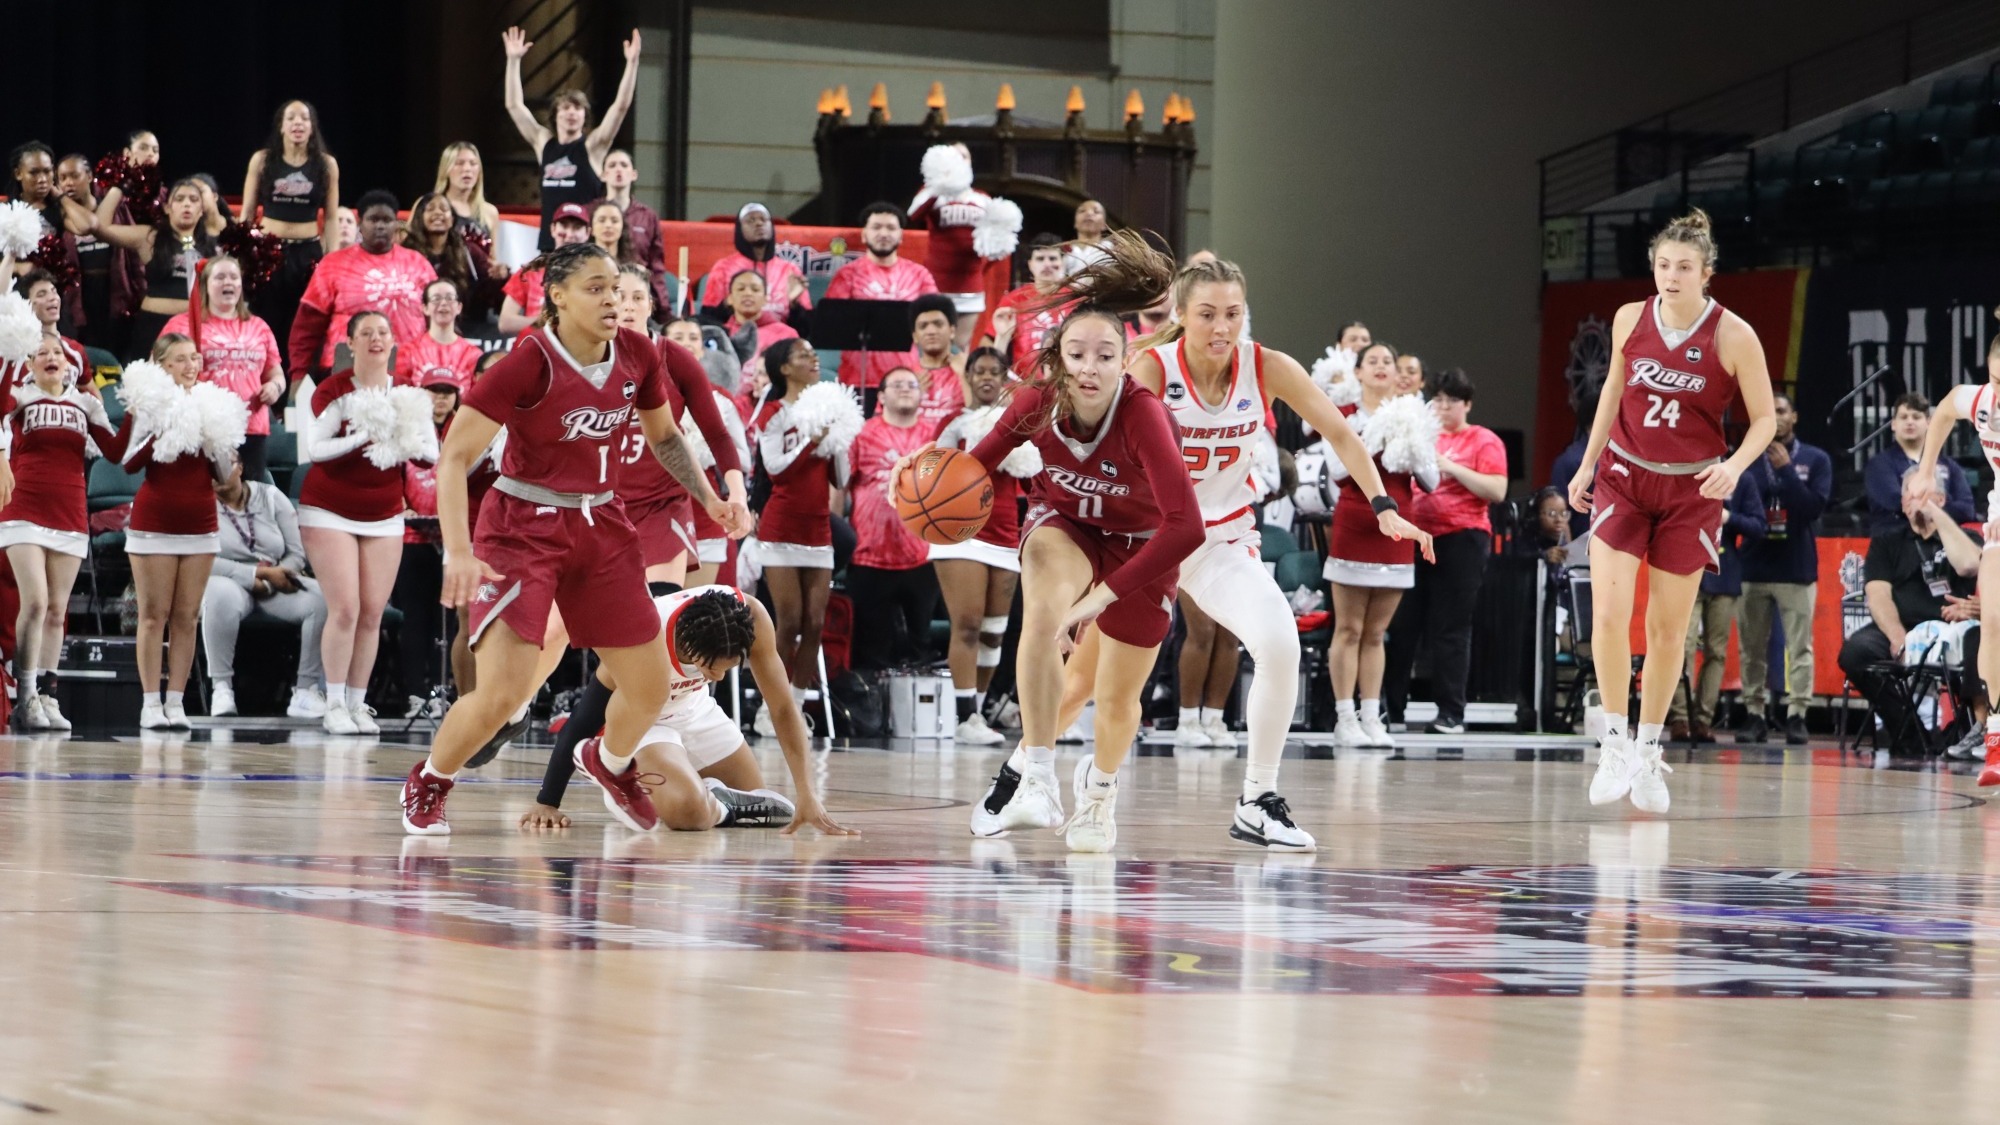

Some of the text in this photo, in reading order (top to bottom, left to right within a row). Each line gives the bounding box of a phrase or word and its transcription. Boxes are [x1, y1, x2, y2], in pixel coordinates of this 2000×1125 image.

[940, 203, 986, 227] RIDE
[1627, 357, 1706, 393] RIDER
[22, 402, 88, 438] RIDER
[1643, 394, 1680, 428] 24
[598, 445, 610, 484] 1
[1044, 463, 1130, 497] RIDER
[1078, 495, 1104, 518] 11
